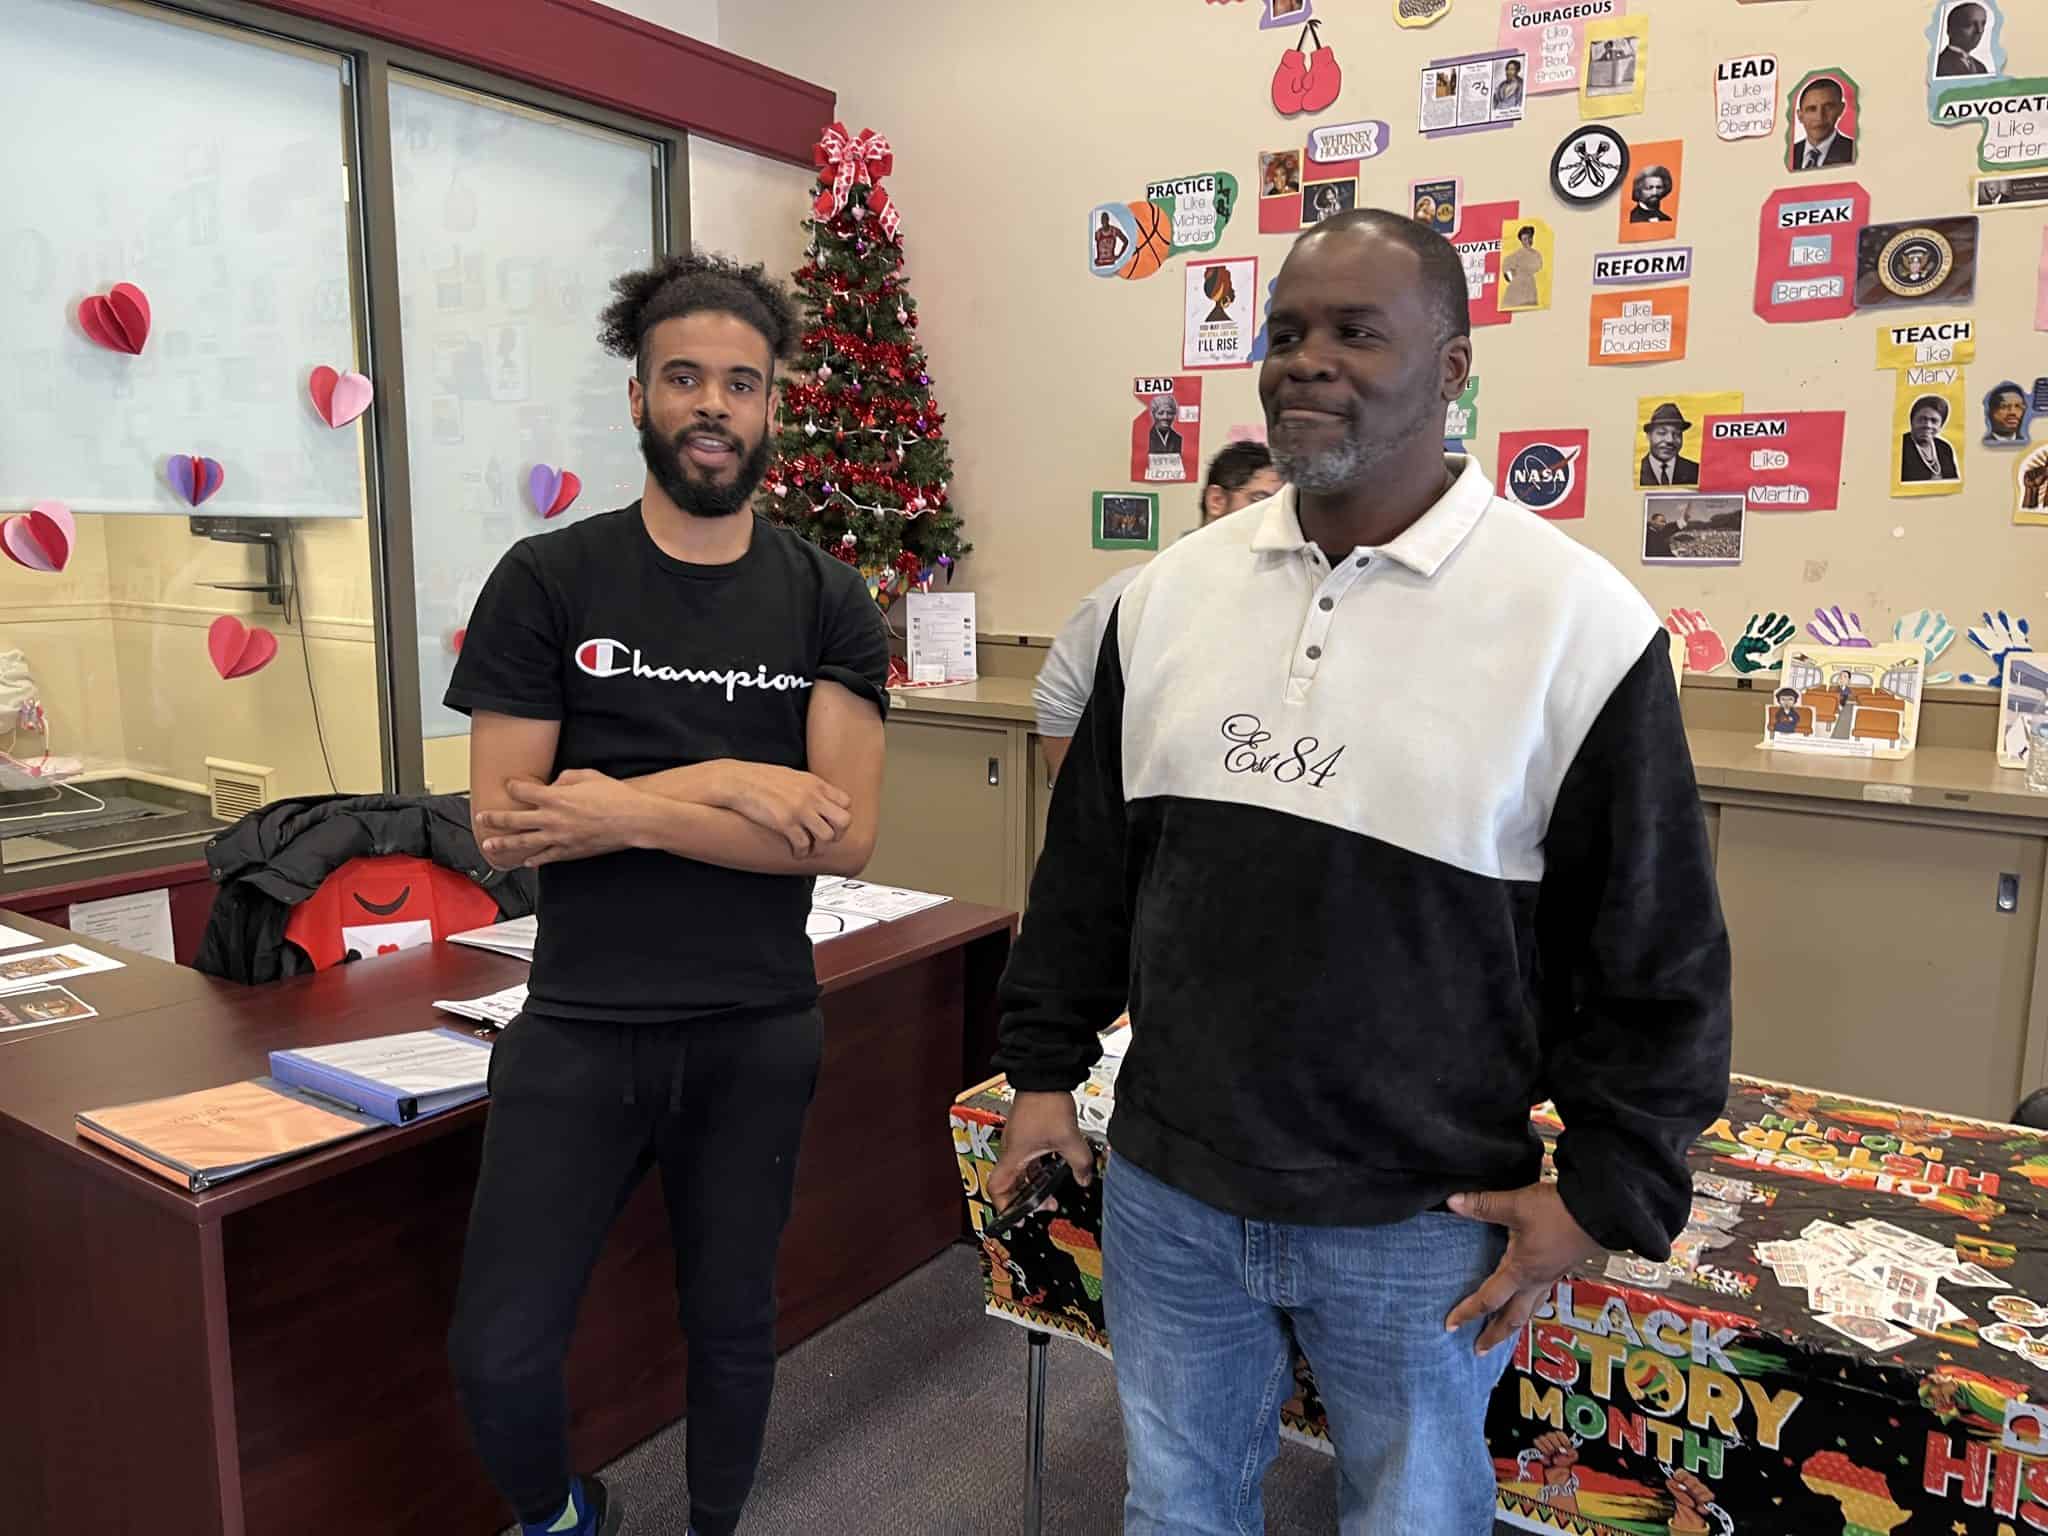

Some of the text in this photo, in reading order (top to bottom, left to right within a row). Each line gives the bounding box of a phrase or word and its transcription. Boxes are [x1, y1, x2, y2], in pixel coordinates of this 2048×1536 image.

[1512, 1, 1612, 28] COURAGEOUS
[1546, 27, 1569, 40] Like
[1717, 58, 1775, 81] LEAD
[1733, 82, 1762, 99] Like
[1721, 100, 1772, 117] Barack
[1717, 117, 1773, 134] Obama
[1997, 119, 2035, 138] Like
[1320, 130, 1372, 146] WHITNEY
[1320, 143, 1371, 158] HOUSTON
[1983, 141, 2048, 162] Carter
[1147, 178, 1214, 198] PRACTICE
[1781, 205, 1850, 227] SPEAK
[1791, 247, 1826, 265] Like
[1596, 255, 1686, 278] REFORM
[1775, 280, 1841, 301] Barack
[1623, 303, 1651, 318] Like
[1602, 318, 1670, 336] Frederick
[1892, 323, 1970, 344] TEACH
[1198, 337, 1239, 352] I'LL RISE
[1603, 337, 1667, 354] Douglass
[1914, 345, 1951, 363] Like
[1907, 368, 1956, 385] Mary
[1135, 379, 1173, 393] LEAD
[1714, 421, 1787, 438] DREAM
[1751, 451, 1786, 468] Like
[1513, 468, 1566, 484] NASA
[1750, 486, 1808, 503] Martin
[575, 638, 813, 702] Champion
[1274, 736, 1346, 788] 84
[1702, 1118, 2000, 1197] HISTORY
[1535, 1282, 1742, 1375] LACK
[1514, 1317, 1804, 1450] ISTORY
[1519, 1377, 1725, 1481] MONTH
